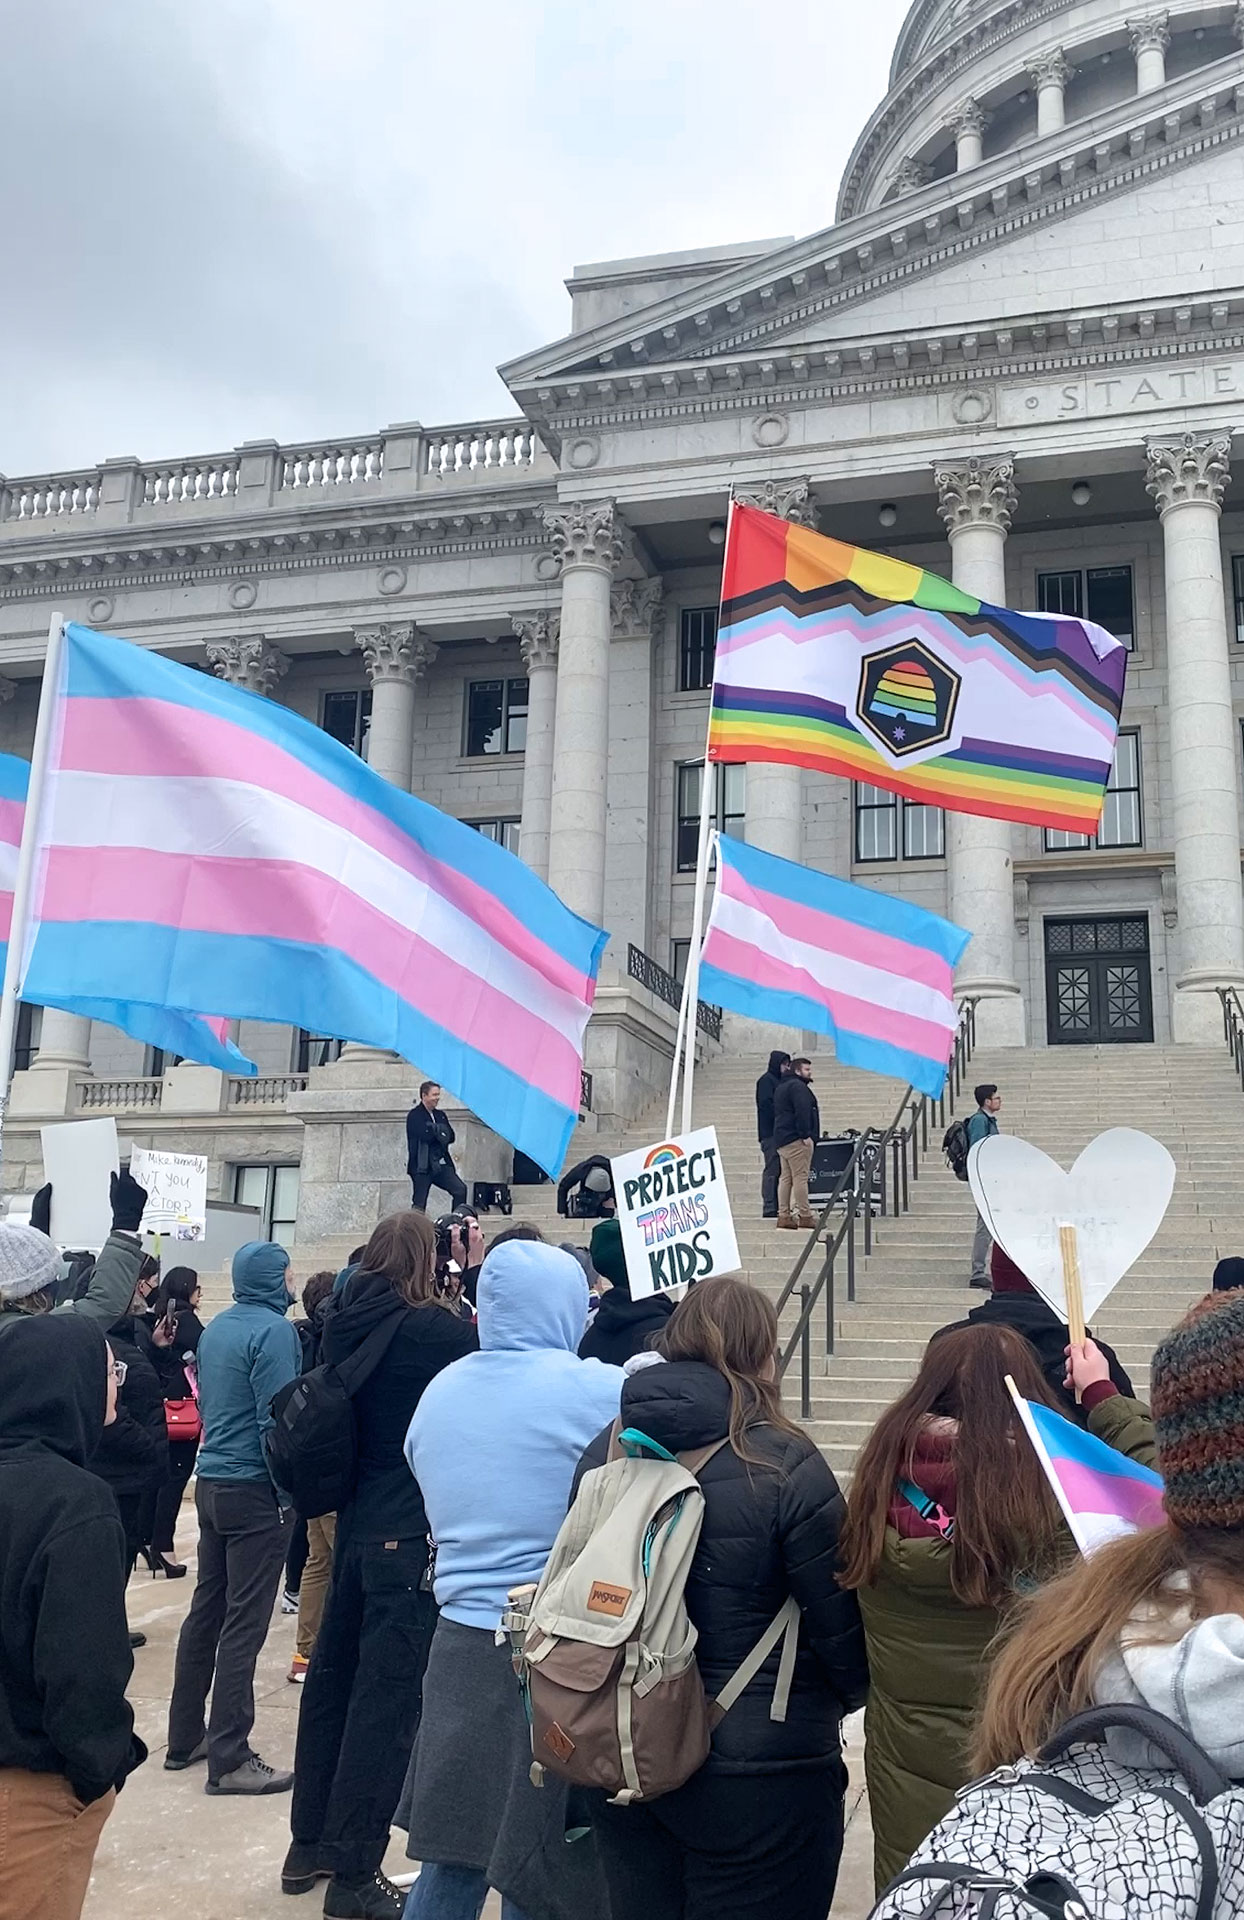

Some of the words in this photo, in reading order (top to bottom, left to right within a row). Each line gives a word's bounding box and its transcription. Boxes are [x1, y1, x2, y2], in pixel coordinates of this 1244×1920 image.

[1060, 366, 1237, 411] STATE
[151, 1185, 160, 1195] A
[623, 1148, 717, 1210] PROTECT
[147, 1197, 192, 1217] CTOR?
[636, 1193, 709, 1246] TRANS
[648, 1230, 714, 1291] KIDS
